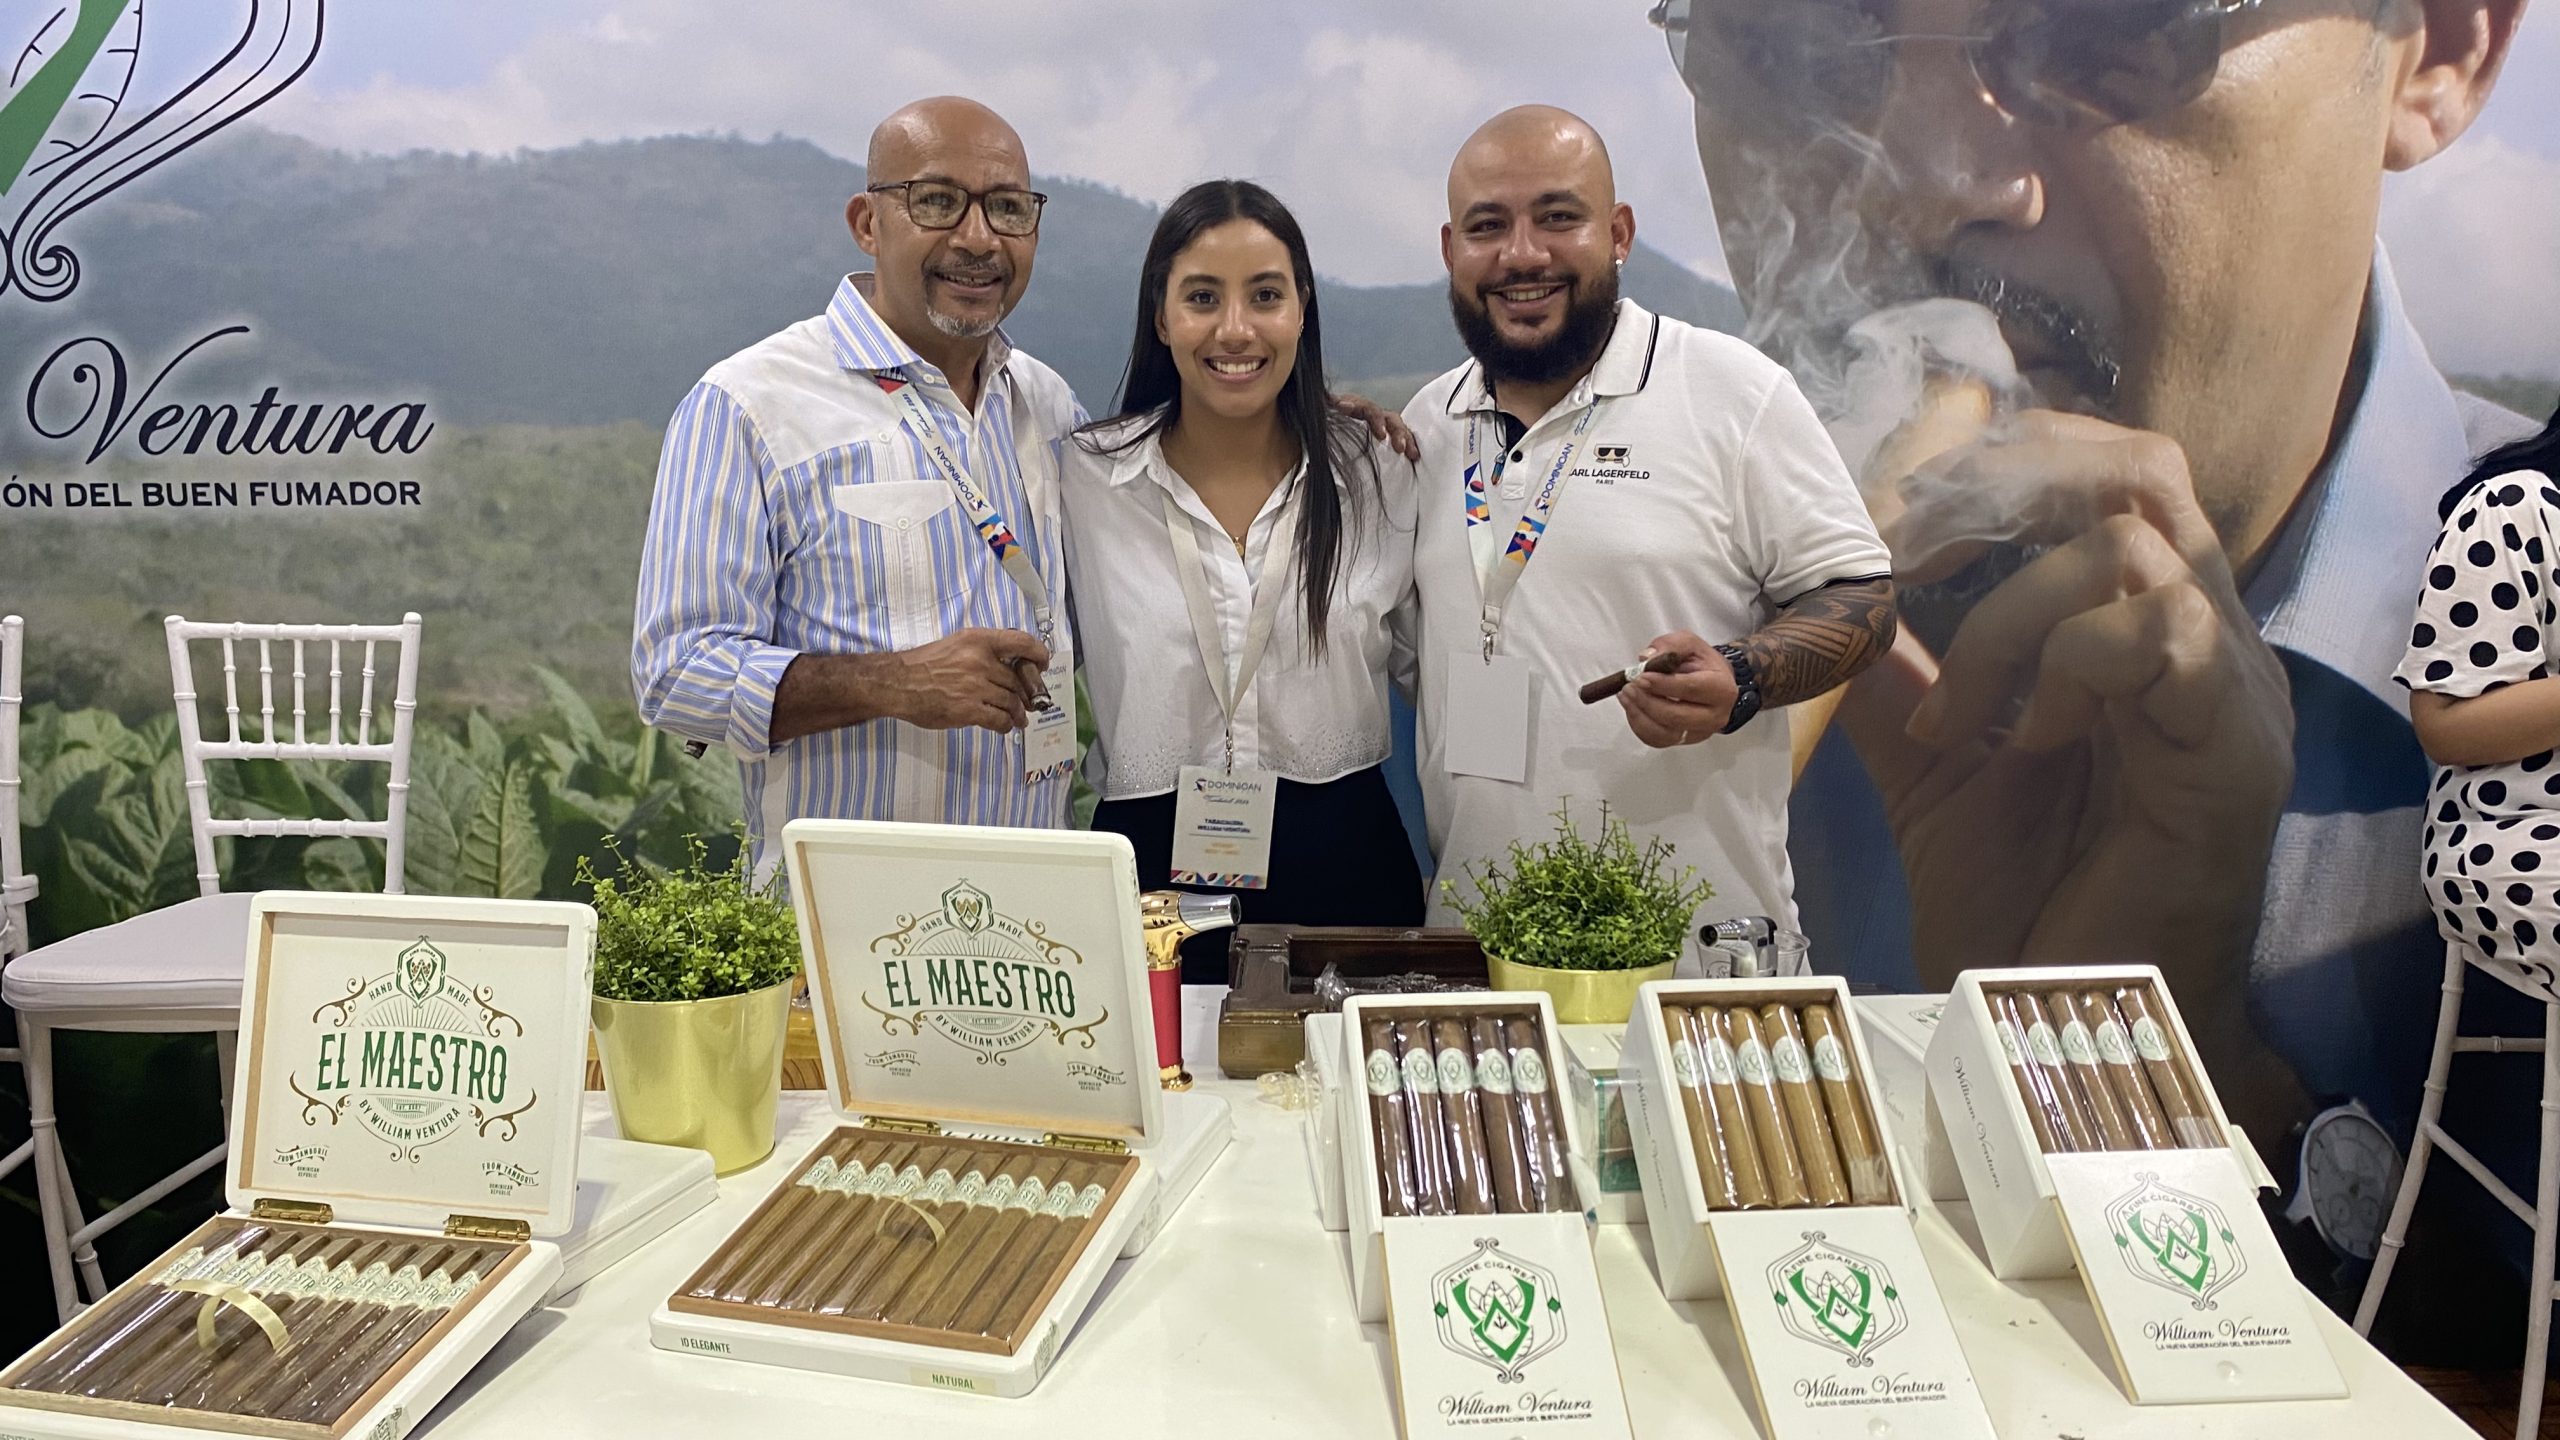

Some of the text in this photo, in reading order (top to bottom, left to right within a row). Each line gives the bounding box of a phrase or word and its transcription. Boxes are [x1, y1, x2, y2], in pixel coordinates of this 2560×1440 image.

[27, 325, 434, 464] Ventura
[933, 446, 974, 500] DOMINICAN
[1541, 442, 1574, 499] DOMINICAN
[1569, 468, 1650, 479] ARL LAGERFELD
[65, 482, 132, 507] DEL
[141, 482, 238, 507] BUEN
[249, 481, 421, 507] FUMADOR
[1207, 780, 1262, 792] DOMINICAN
[919, 917, 1025, 939] HAND MADE
[368, 980, 471, 1008] HAND MADE
[883, 958, 1076, 1019] EL MAESTRO
[936, 1014, 1036, 1047] BY WILLIAM VENTURA
[317, 1030, 507, 1104] EL MAESTRO
[359, 1099, 461, 1140] BY WILLIAM VENTURA
[1953, 1056, 2000, 1190] William Ventura
[1458, 1260, 1527, 1279] FINE CIGARS
[1790, 1252, 1859, 1270] FINE CIGARS
[2143, 1316, 2290, 1342] William Ventura
[690, 1338, 732, 1354] ELEGANTE
[932, 1373, 976, 1390] NATURAL
[1793, 1372, 1945, 1399] William Ventura
[1438, 1388, 1593, 1417] William Ventura
[1805, 1400, 1814, 1408] LA
[1447, 1418, 1456, 1426] LA
[1526, 1415, 1539, 1423] DEL
